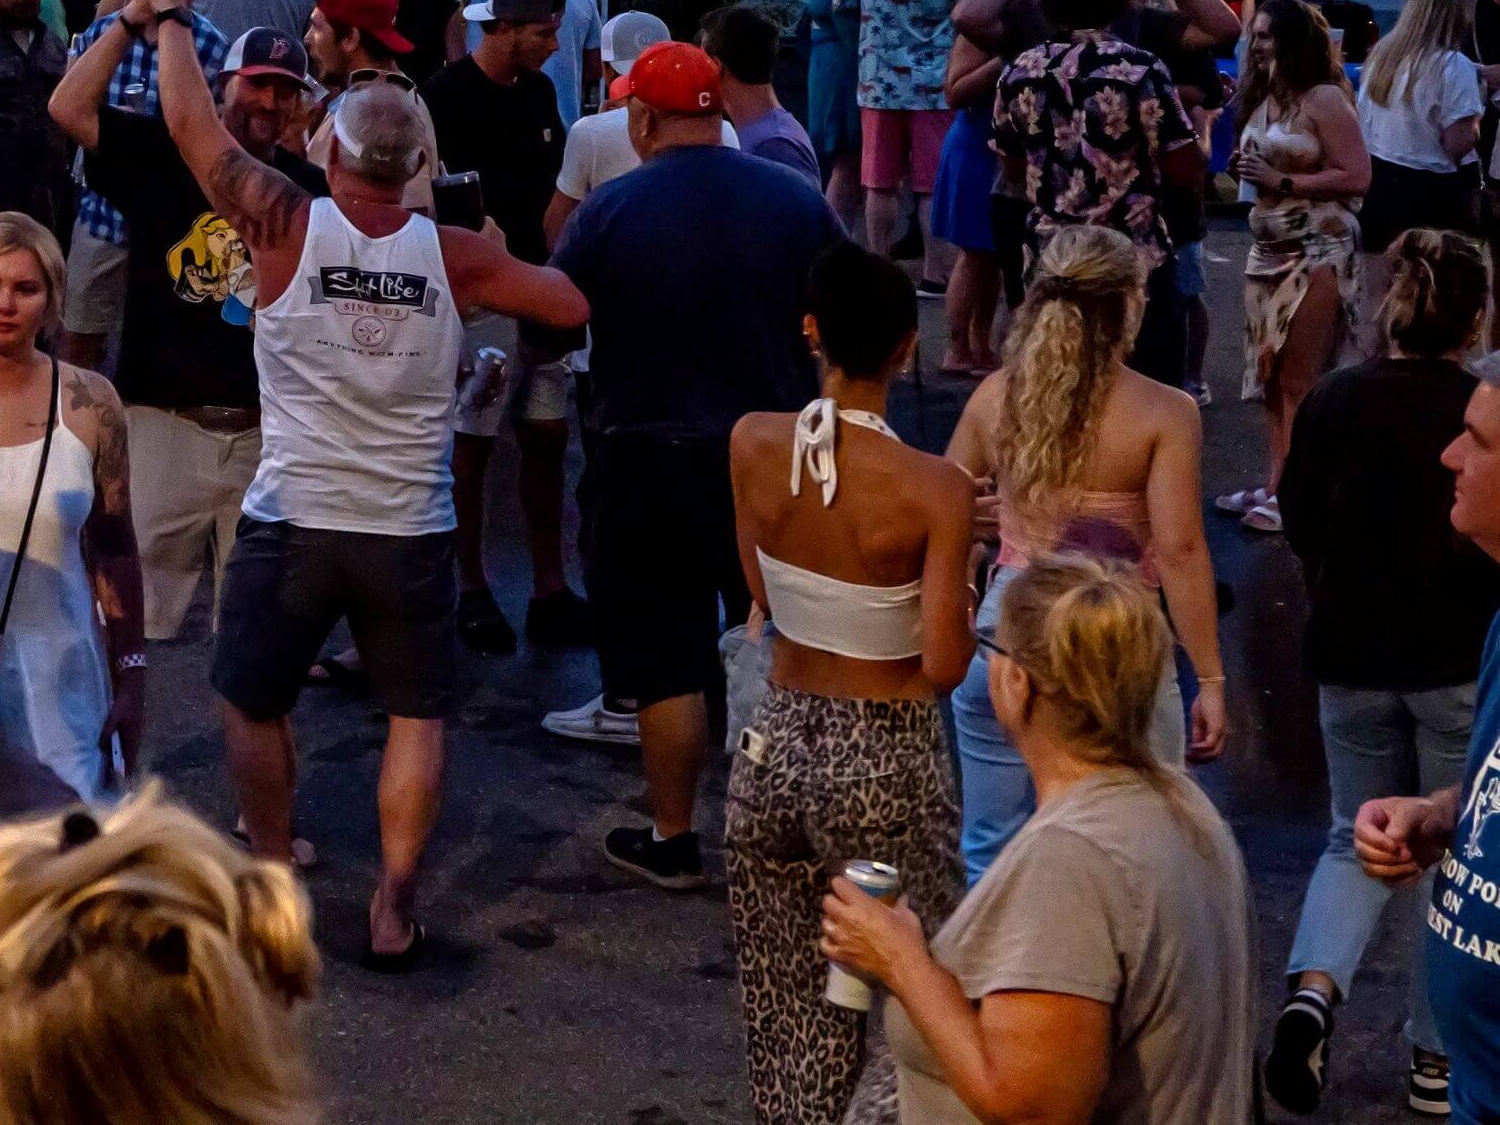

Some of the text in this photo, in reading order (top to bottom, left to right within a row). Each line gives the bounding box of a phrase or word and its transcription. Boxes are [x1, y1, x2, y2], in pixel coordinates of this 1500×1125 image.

[698, 91, 711, 107] C
[379, 272, 420, 300] Life
[343, 301, 400, 317] SINCE 03
[1442, 889, 1464, 915] ON
[1468, 872, 1500, 910] PO
